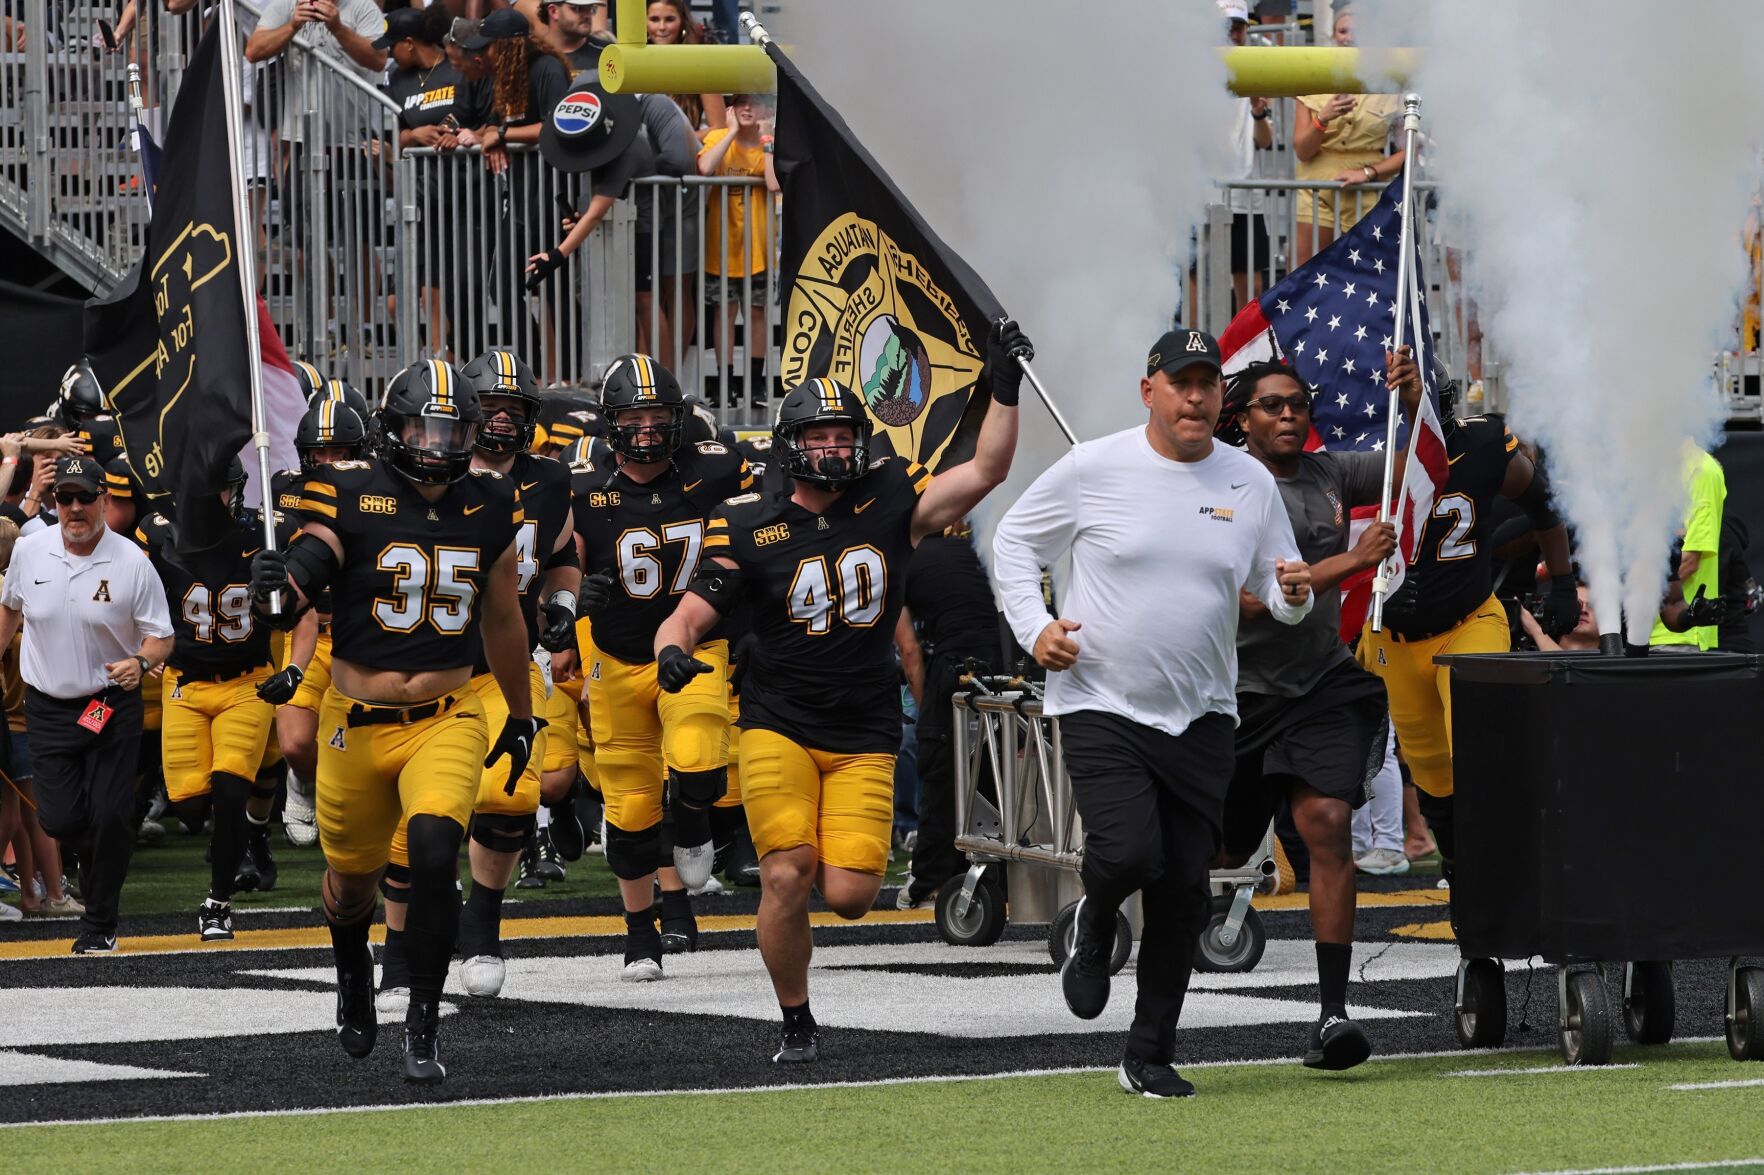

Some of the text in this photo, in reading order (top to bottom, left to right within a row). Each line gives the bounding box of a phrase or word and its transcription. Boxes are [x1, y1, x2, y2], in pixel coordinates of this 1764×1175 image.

[557, 104, 598, 119] PEPSI
[1186, 331, 1208, 353] A
[66, 459, 83, 474] A
[359, 495, 397, 515] SBC
[753, 522, 790, 547] SBC
[817, 516, 829, 530] A
[515, 520, 539, 595] 4
[616, 518, 705, 599] 67
[92, 579, 113, 602] A
[372, 542, 481, 635] 35
[786, 543, 888, 635] 40
[182, 583, 254, 644] 49
[88, 705, 105, 723] A
[328, 725, 347, 752] A
